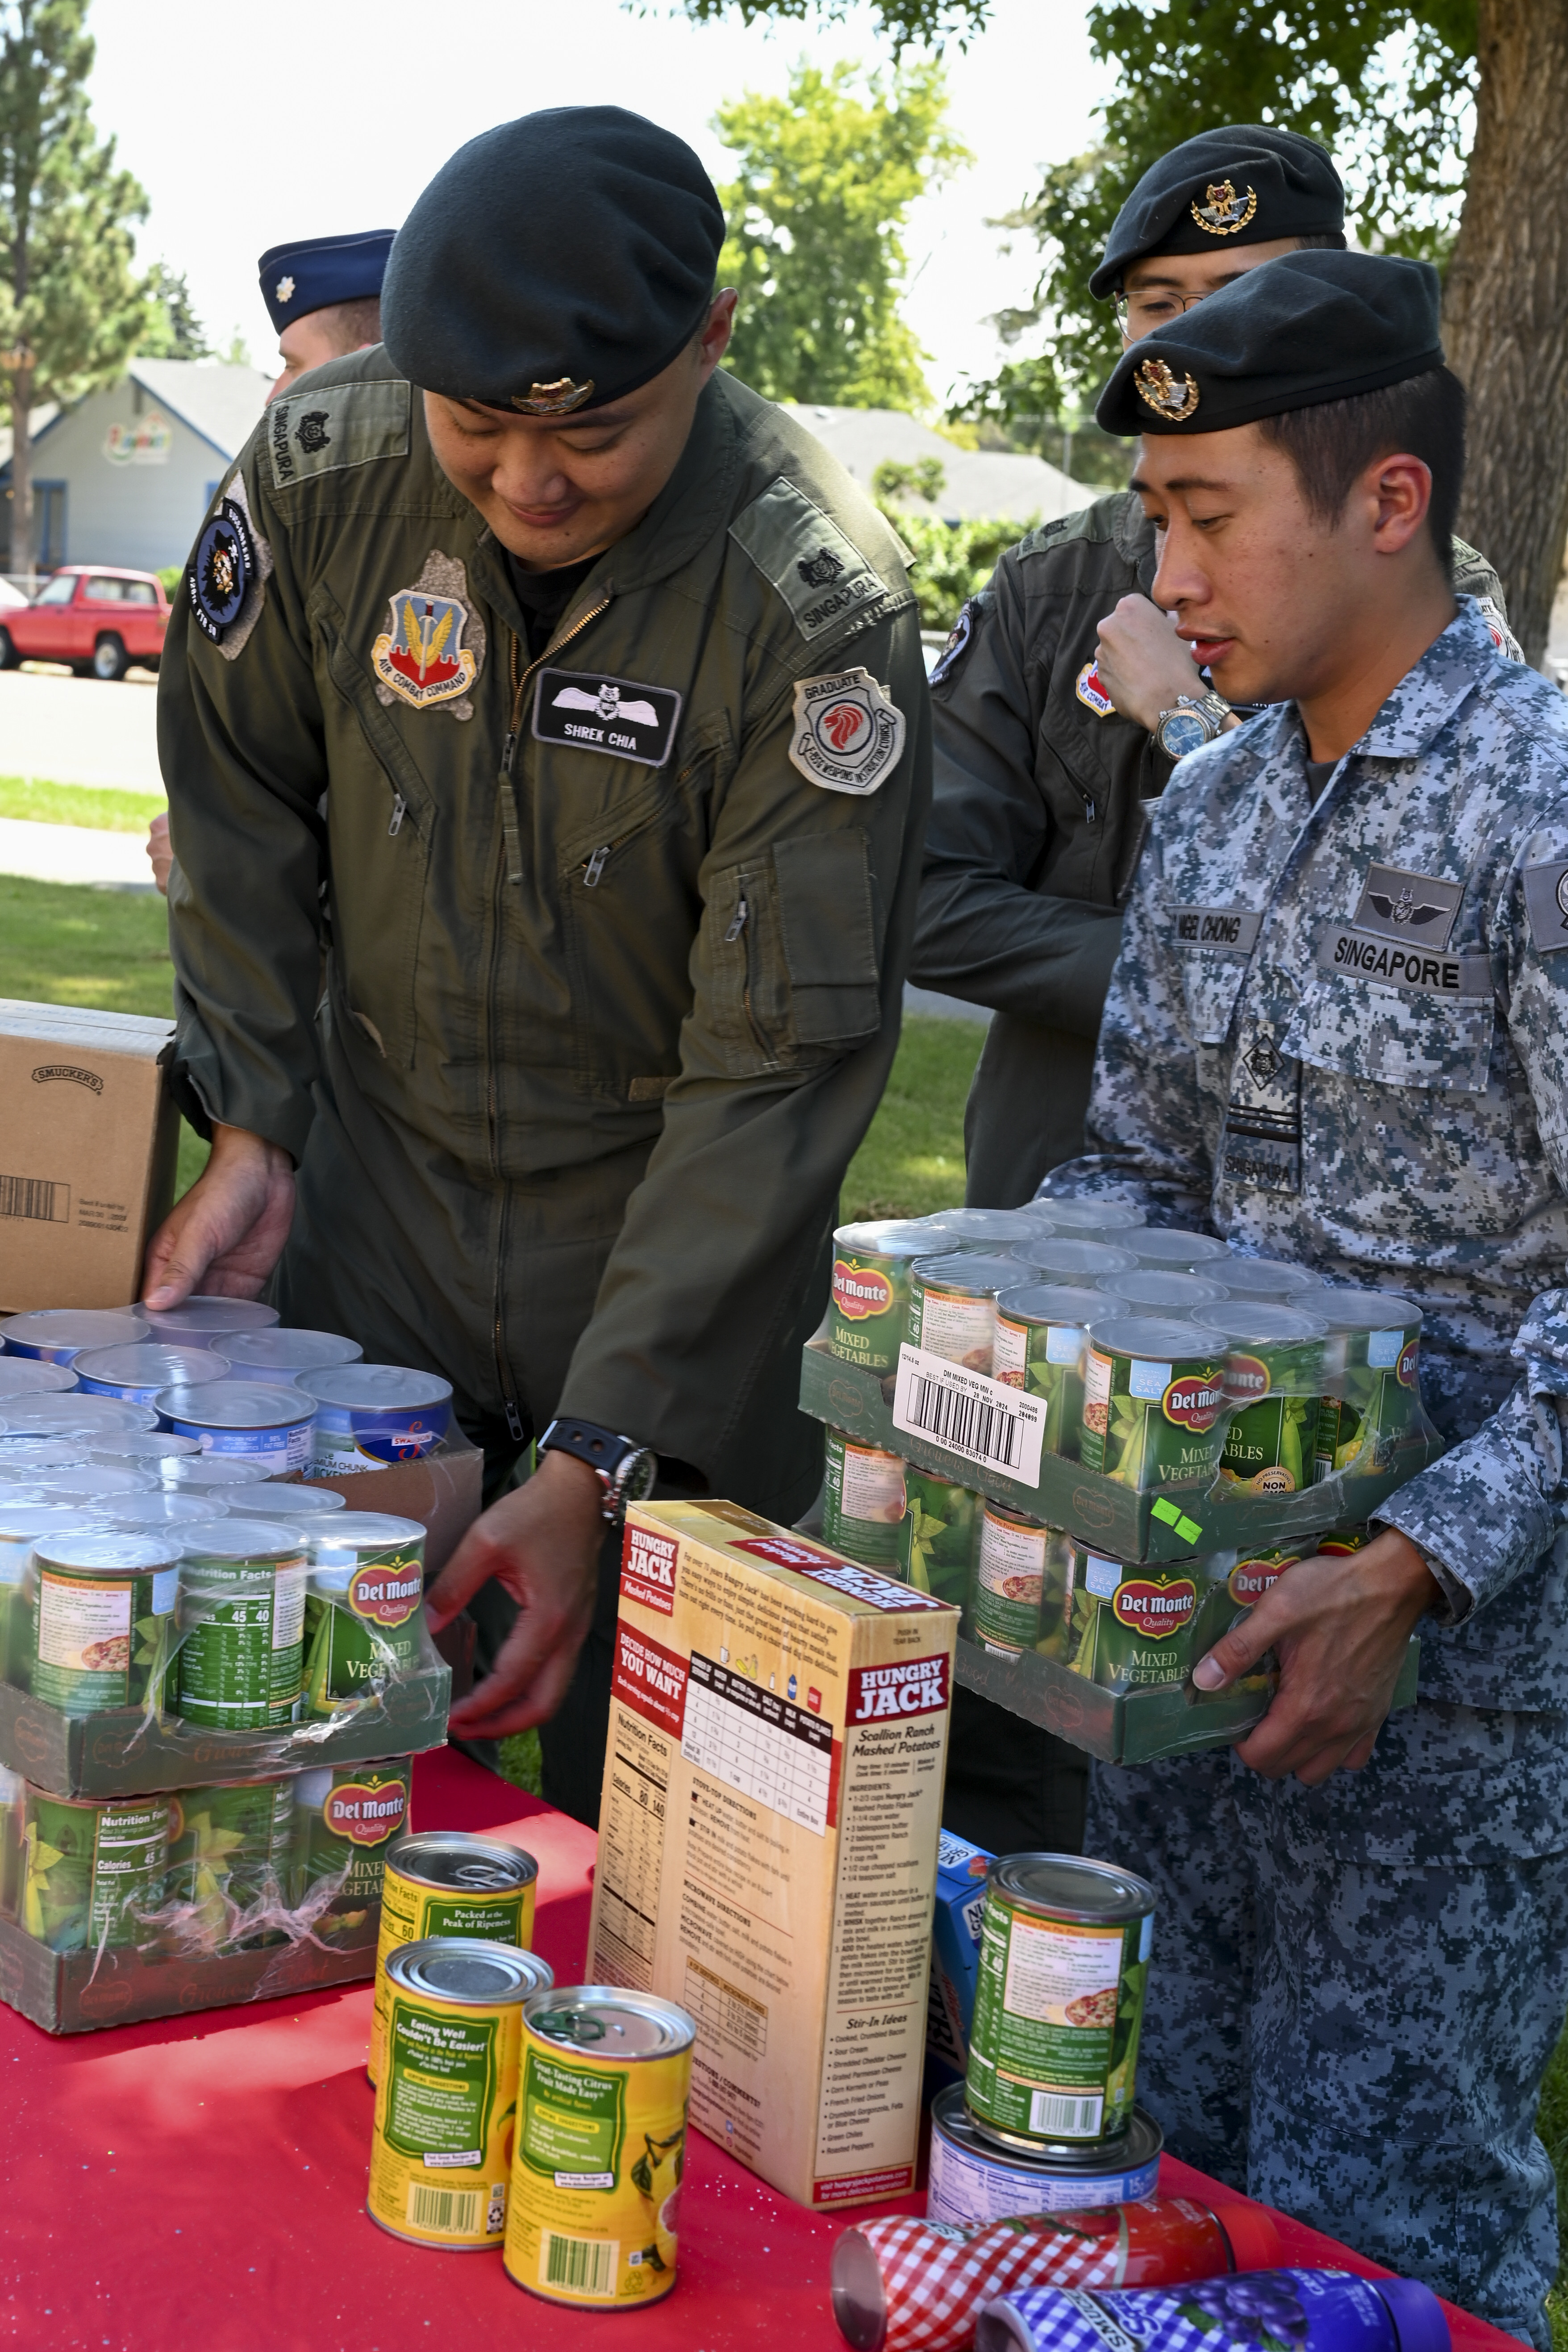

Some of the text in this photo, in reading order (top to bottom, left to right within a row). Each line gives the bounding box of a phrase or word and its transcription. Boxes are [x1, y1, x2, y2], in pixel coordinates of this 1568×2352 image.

[274, 406, 294, 481] SINGAPURA
[804, 575, 878, 628] SINGAPURA
[379, 658, 466, 701] AIR COMBAT COMMAND
[805, 674, 861, 699] GRADUATE
[1080, 681, 1110, 711] AIR COMBAT
[564, 723, 637, 751] SHREK CHIA
[1334, 936, 1460, 989] SINGAPORE
[38, 1067, 98, 1088] SMUCKER'S
[1224, 1156, 1291, 1183] SINGAPURA
[833, 1272, 888, 1302] Del Monte
[925, 1290, 941, 1299] Chicken
[841, 1297, 865, 1313] Quality
[835, 1326, 870, 1349] MIXED
[913, 1323, 920, 1334] 40
[1402, 1356, 1416, 1373] Del
[926, 1372, 939, 1381] BEST
[945, 1378, 960, 1390] USED
[960, 1385, 968, 1393] BY
[943, 1369, 951, 1378] DM
[952, 1372, 967, 1385] MIXED
[968, 1379, 979, 1389] VEG
[980, 1384, 989, 1394] MW
[1135, 1386, 1164, 1395] SALT
[1139, 1378, 1161, 1387] SEA
[973, 1391, 980, 1400] 28
[982, 1395, 993, 1405] NOV
[1171, 1392, 1196, 1410] Del
[1191, 1412, 1215, 1423] Quality
[940, 1437, 947, 1446] 00
[948, 1441, 965, 1454] 24000
[966, 1448, 983, 1462] 83074
[338, 1462, 369, 1472] CHUNK
[976, 1466, 1013, 1493] Good
[1256, 1470, 1292, 1486] NO PRESERVATIVES
[1263, 1481, 1286, 1490] NON
[1003, 1522, 1015, 1531] Pizza
[631, 1529, 676, 1560] HUNGRY
[240, 1570, 272, 1580] Facts
[627, 1545, 674, 1587] JACK
[801, 1569, 901, 1609] HUNGRY
[822, 1564, 939, 1608] JACK
[1090, 1582, 1114, 1594] SALT
[1093, 1575, 1111, 1586] SEA
[1236, 1574, 1263, 1592] Del
[358, 1582, 384, 1600] Del
[624, 1580, 672, 1611] Mashed Potatoes
[379, 1604, 409, 1617] Quality
[1121, 1594, 1193, 1613] Del Monte
[231, 1610, 269, 1623] 45 40
[1143, 1617, 1175, 1628] Quality
[620, 1632, 686, 1683] DECIDE HOW MUCH
[1131, 1650, 1178, 1667] MIXED
[621, 1647, 682, 1701] YOU WANT
[860, 1659, 943, 1689] HUNGRY
[1109, 1663, 1190, 1684] VEGETABLES
[855, 1676, 945, 1719] JACK
[618, 1713, 668, 1757] Nutrition Facts
[858, 1723, 935, 1743] Scallion Ranch
[852, 1739, 941, 1757] Mashed Potatoes
[612, 1772, 631, 1794] Calories
[849, 1783, 891, 1792] INGREDIENTS:
[333, 1797, 404, 1819] Del Monte
[639, 1789, 665, 1818] 80 140
[692, 1777, 757, 1820] STOVE-TOP DIRECTIONS
[101, 1814, 150, 1827] Nutrition
[355, 1823, 387, 1835] Quality
[97, 1860, 131, 1871] Calories
[144, 1852, 155, 1864] 45
[399, 1886, 418, 1903] Facts
[684, 1879, 751, 1927] MICROWAVE DIRECTIONS
[443, 1918, 511, 1931] Peak of Ripeness
[454, 1910, 485, 1919] Packed
[402, 1926, 414, 1939] 60
[410, 2018, 466, 2040] Eating Well
[846, 2014, 908, 2030] Stir-In Ideas
[396, 2023, 485, 2052] Couldn't Be Easier!
[533, 2059, 613, 2091] Great-Tasting Citrus
[536, 2073, 554, 2089] Fruit
[553, 2081, 578, 2096] Made
[846, 2131, 863, 2139] Chiles
